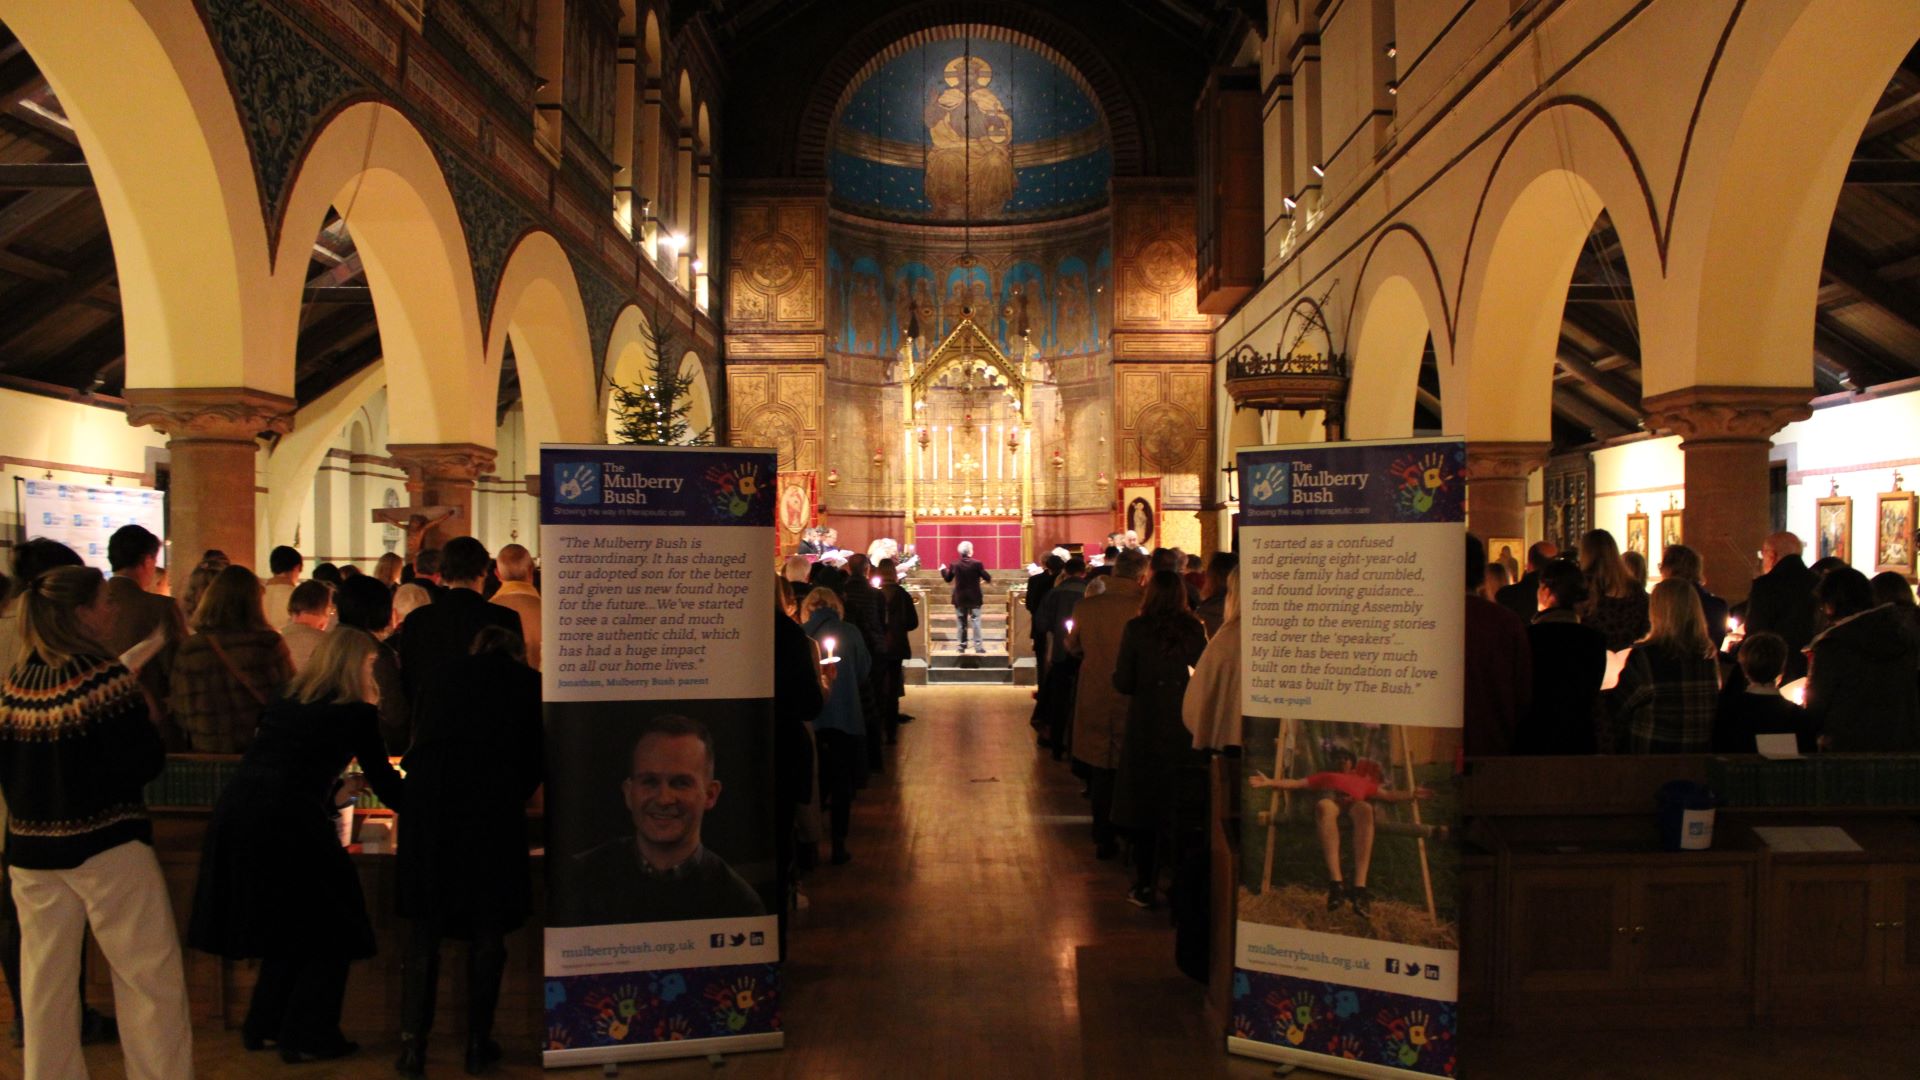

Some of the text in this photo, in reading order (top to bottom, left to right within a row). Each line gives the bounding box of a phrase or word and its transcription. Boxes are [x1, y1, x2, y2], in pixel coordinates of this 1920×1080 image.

[604, 462, 624, 473] The
[1292, 461, 1312, 471] The
[604, 474, 684, 493] Mulberry
[1292, 472, 1369, 489] Mulberry
[604, 489, 647, 504] Bush
[1292, 489, 1334, 504] Bush
[594, 538, 652, 554] Mulberry
[655, 538, 687, 549] Bush
[690, 539, 701, 549] is
[1264, 538, 1307, 549] started
[1310, 539, 1323, 549] as
[1327, 539, 1334, 548] a
[1338, 536, 1394, 548] confused
[558, 553, 747, 567] extraordinary. It has changed
[1252, 552, 1416, 567] and grieving eight-year-old
[558, 566, 752, 581] our adopted son for the better
[1252, 566, 1425, 582] whose family had crumbled,
[558, 584, 748, 598] and given us new found hope
[1252, 585, 1273, 595] and
[1277, 584, 1313, 597] found
[1316, 585, 1355, 599] loving
[558, 599, 578, 611] for
[581, 599, 602, 610] the
[698, 599, 744, 609] started
[1251, 600, 1424, 616] from the morning Assembly
[559, 614, 725, 625] to see a calmer and much
[1252, 615, 1436, 632] through to the evening stories
[558, 629, 740, 641] more authentic child, which
[1251, 631, 1277, 642] read
[1280, 633, 1306, 643] over
[1311, 632, 1330, 643] the
[559, 644, 706, 658] has had a huge impact
[1251, 647, 1418, 663] My life has been very much
[558, 662, 576, 672] on
[579, 660, 595, 672] all
[598, 662, 621, 671] our
[624, 660, 662, 671] home
[1251, 661, 1438, 679] built on the foundation of love
[606, 678, 649, 687] Mulberry
[652, 678, 675, 686] Bush
[678, 678, 709, 686] parent
[1252, 677, 1275, 688] that
[1279, 680, 1301, 689] was
[1305, 678, 1334, 691] built
[1337, 680, 1352, 693] by
[1355, 681, 1377, 693] The
[561, 941, 696, 959] mulberrybush.org.uk
[1247, 944, 1370, 970] mulberrybush.org.uk
